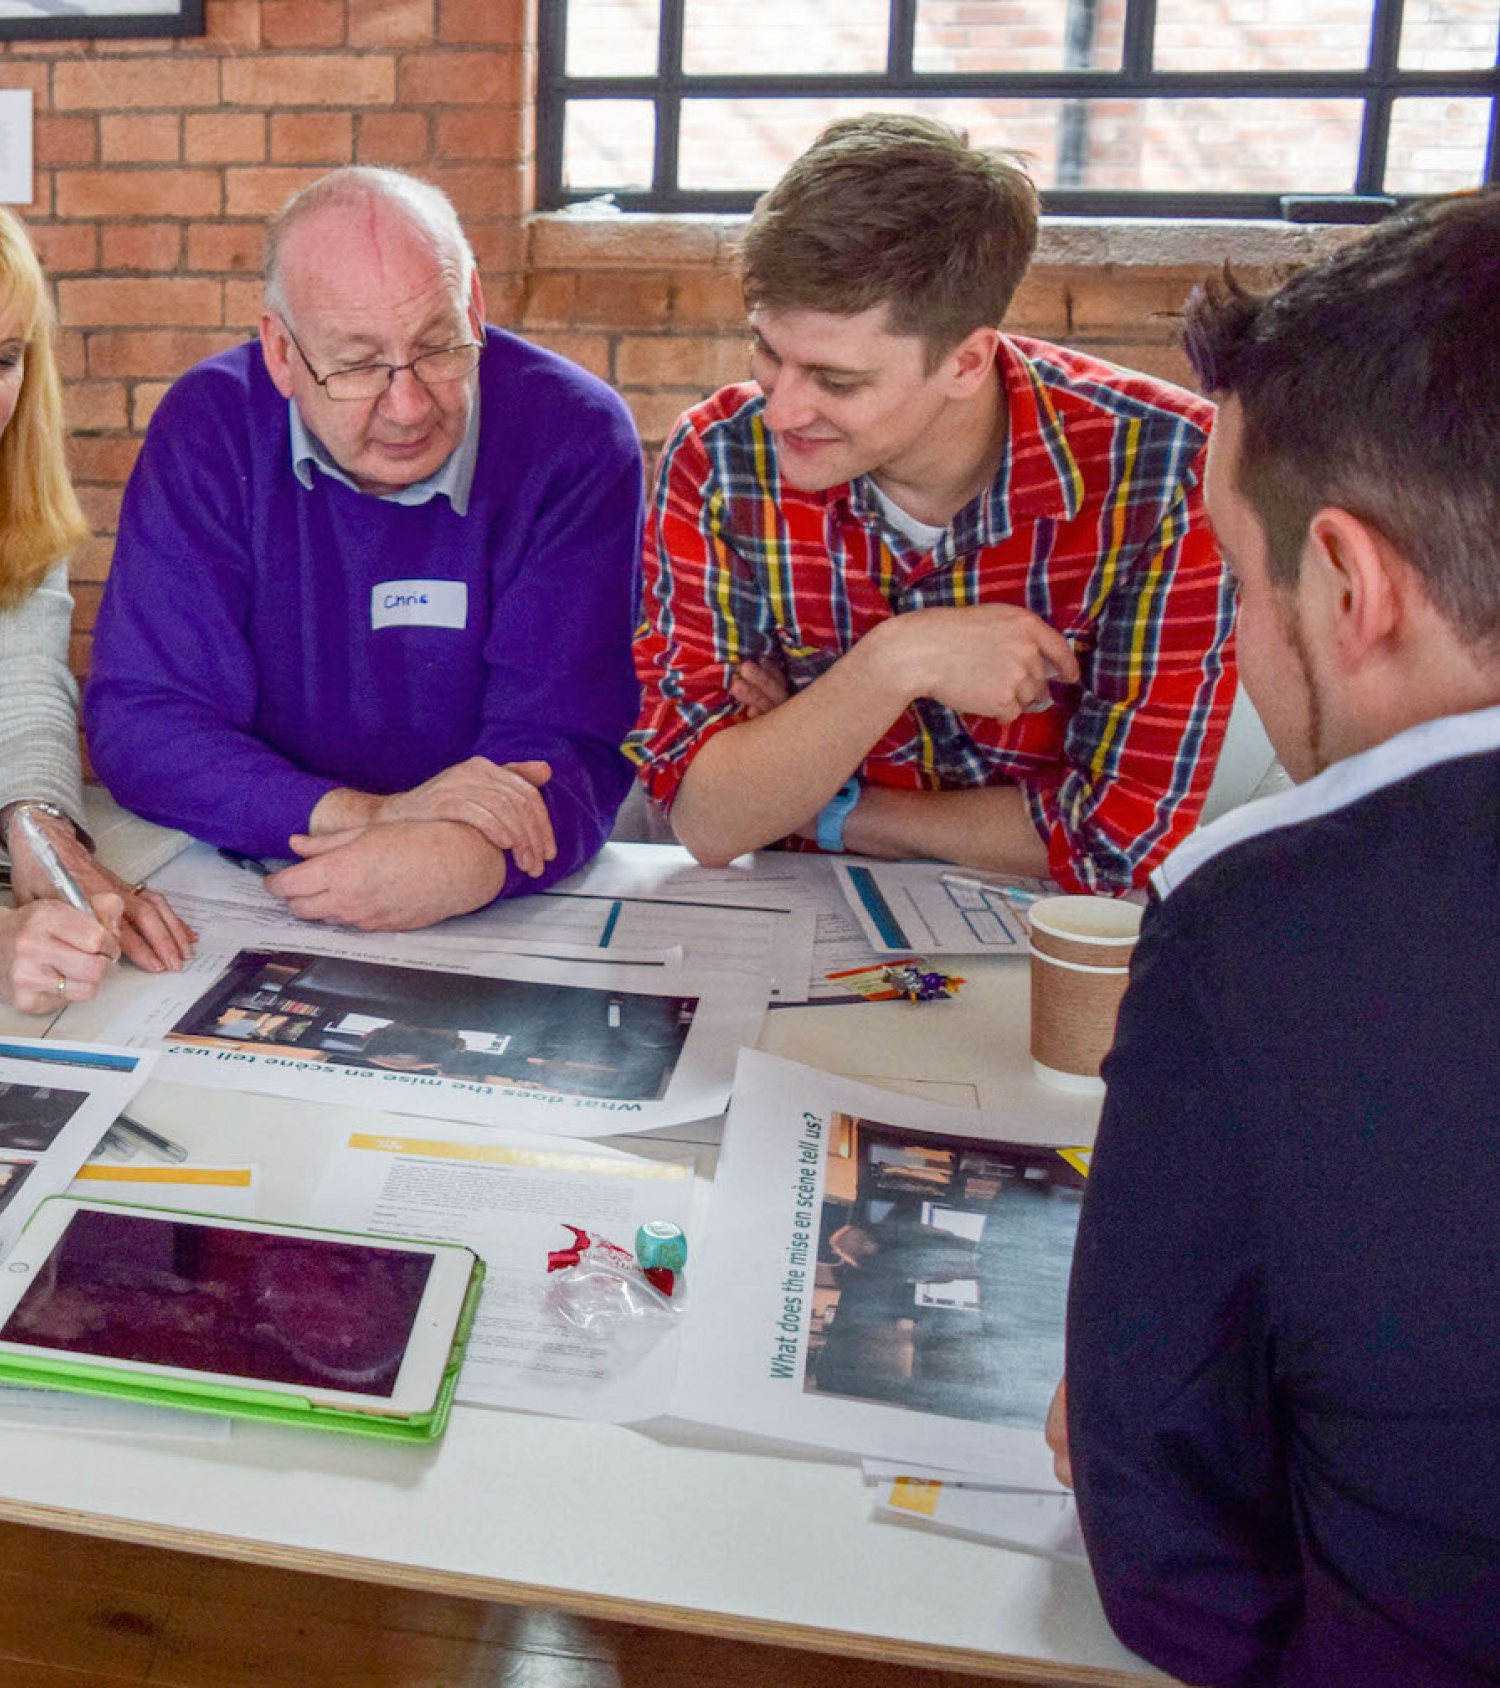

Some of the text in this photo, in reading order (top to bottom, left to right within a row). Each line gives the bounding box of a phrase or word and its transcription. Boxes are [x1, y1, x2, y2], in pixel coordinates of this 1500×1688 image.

[167, 1047, 210, 1056] us?
[217, 1052, 256, 1063] tell
[344, 1069, 375, 1078] en
[382, 1073, 443, 1087] mise
[450, 1082, 494, 1095] the
[501, 1088, 564, 1104] does
[573, 1098, 643, 1112] What
[802, 1111, 822, 1139] us?
[798, 1140, 819, 1165] tell
[794, 1211, 812, 1229] en
[785, 1232, 810, 1266] mise
[780, 1270, 805, 1292] the
[775, 1296, 802, 1332] does
[769, 1335, 799, 1379] What
